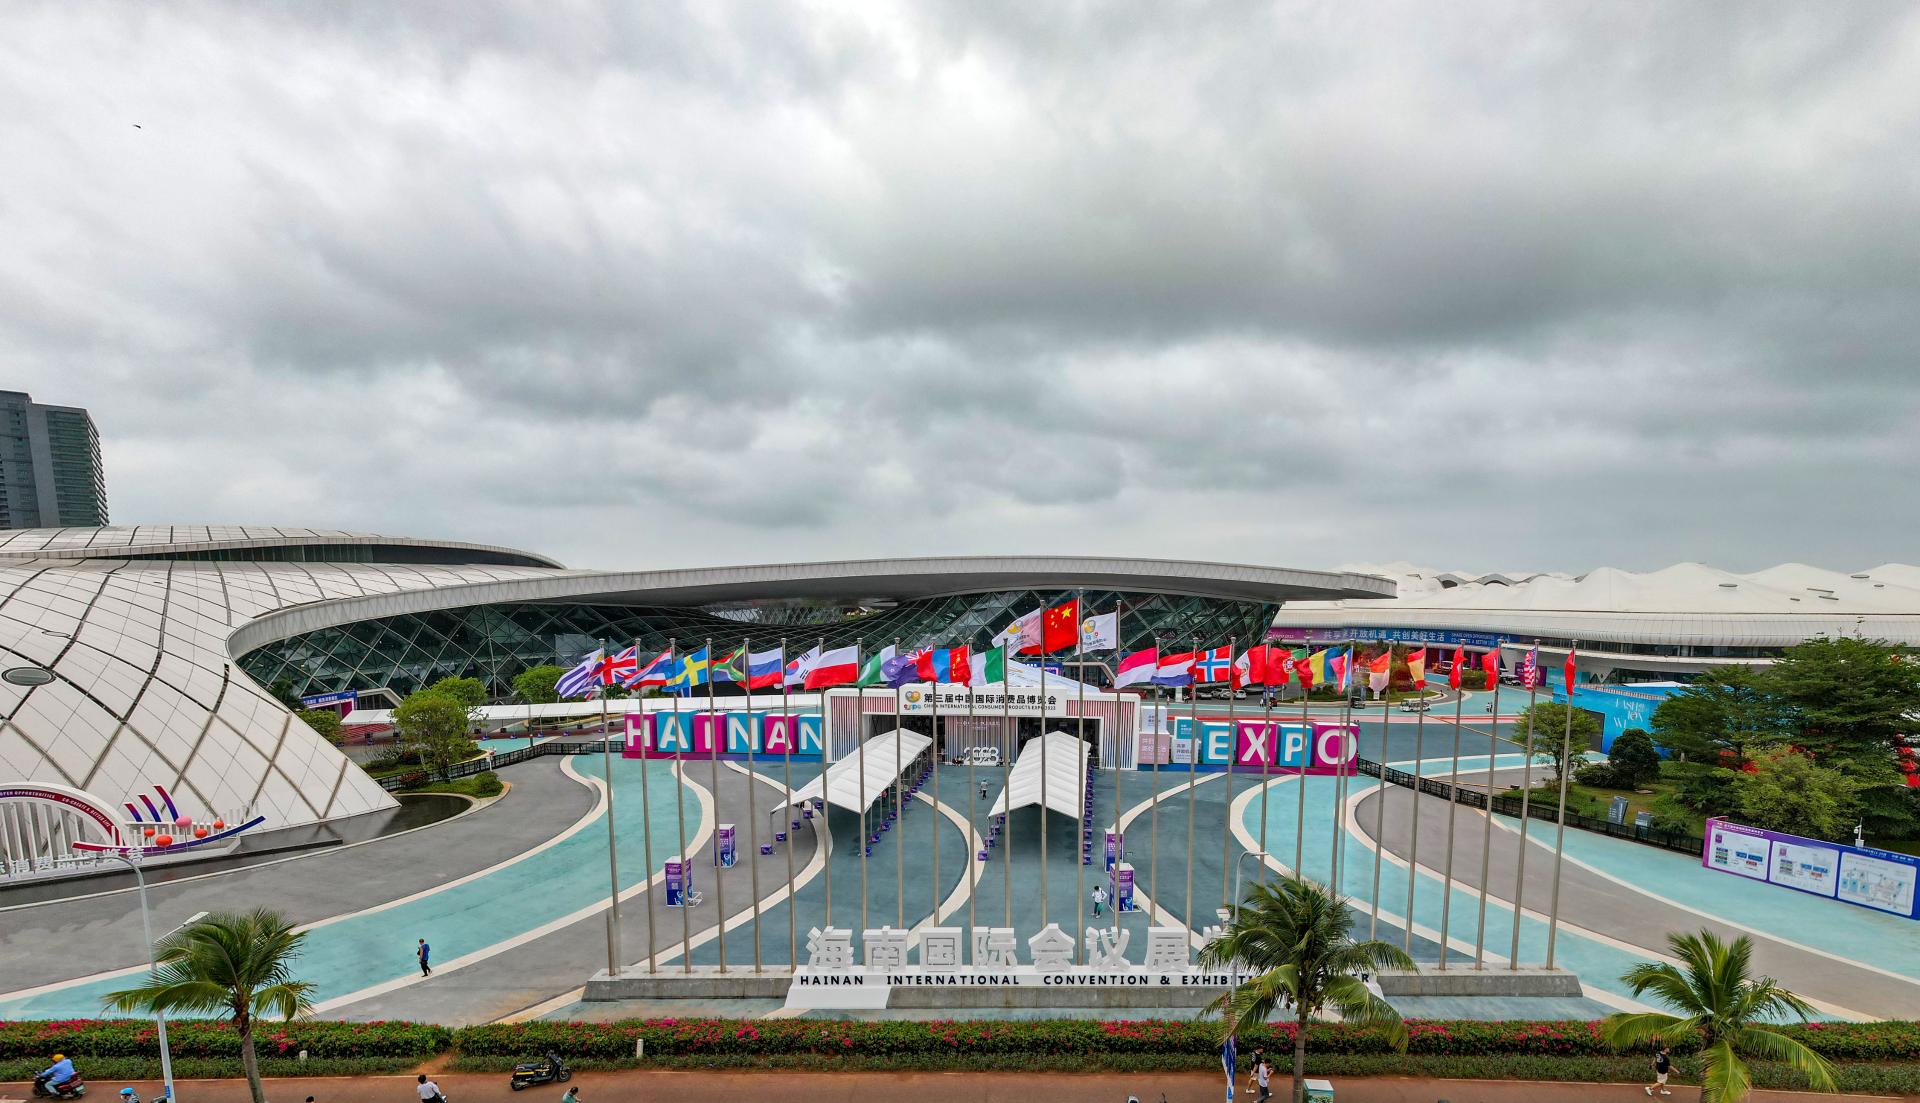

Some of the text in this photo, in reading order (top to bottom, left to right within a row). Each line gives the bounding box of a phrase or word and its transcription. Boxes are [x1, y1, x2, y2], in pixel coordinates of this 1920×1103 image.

[627, 716, 822, 750] HAINAN
[1208, 727, 1357, 765] EXPO
[806, 923, 1222, 972] 海南国际会议展
[800, 975, 1253, 985] HAINAN INTERNATIONAL CONVENTION & EXHIBT
